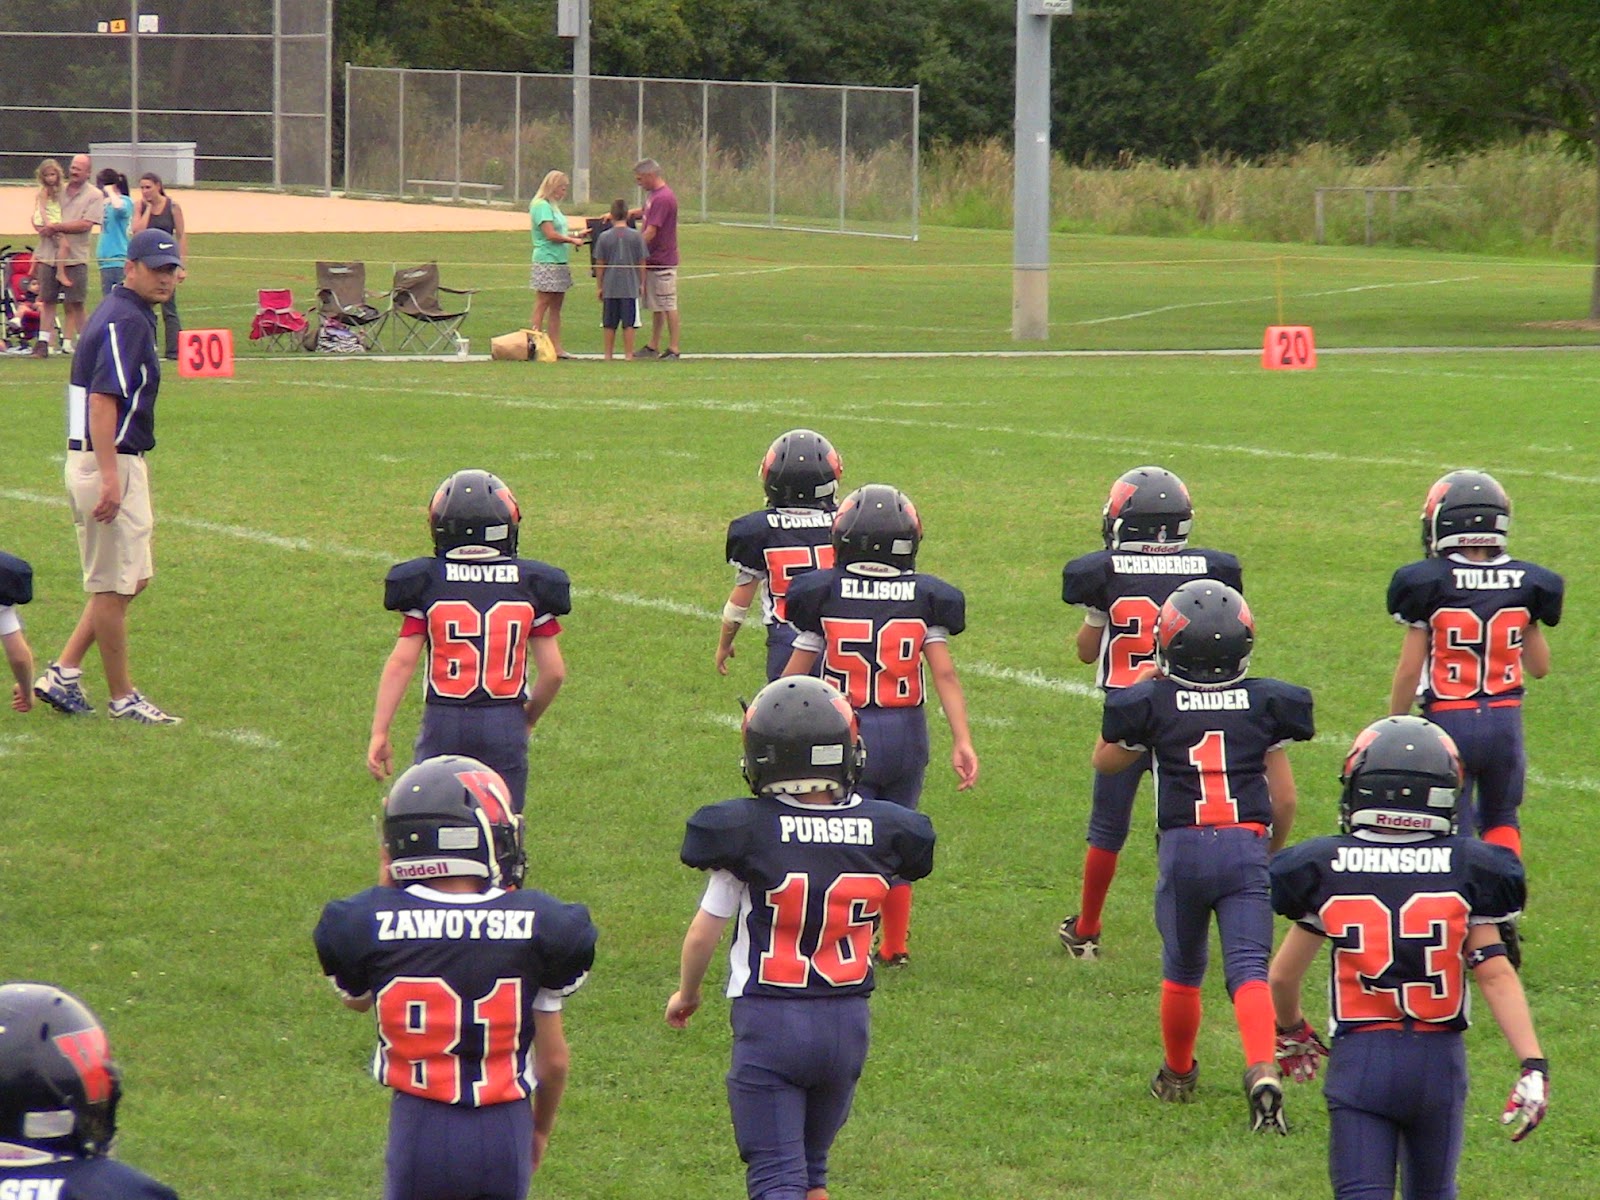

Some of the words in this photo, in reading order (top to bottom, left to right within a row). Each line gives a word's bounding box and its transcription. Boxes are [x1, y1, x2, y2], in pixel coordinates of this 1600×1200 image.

[188, 334, 223, 370] 30
[1278, 331, 1308, 365] 20
[1458, 536, 1498, 546] Riddell
[445, 563, 519, 583] HOOVER
[763, 544, 836, 623] 5
[841, 578, 916, 600] ELLISON
[1452, 568, 1526, 590] TULLEY
[426, 600, 535, 699] 60
[819, 616, 928, 709] 58
[1429, 606, 1532, 699] 66
[1176, 688, 1250, 711] CRIDER
[1188, 730, 1239, 825] 1
[779, 815, 874, 846] PURSER
[1376, 813, 1432, 829] Riddell
[395, 862, 449, 877] Riddell
[1331, 848, 1452, 873] JOHNSON
[375, 909, 536, 941] ZAWOYSKI
[758, 872, 891, 988] 16
[1318, 891, 1472, 1023] 23
[375, 976, 527, 1108] 81
